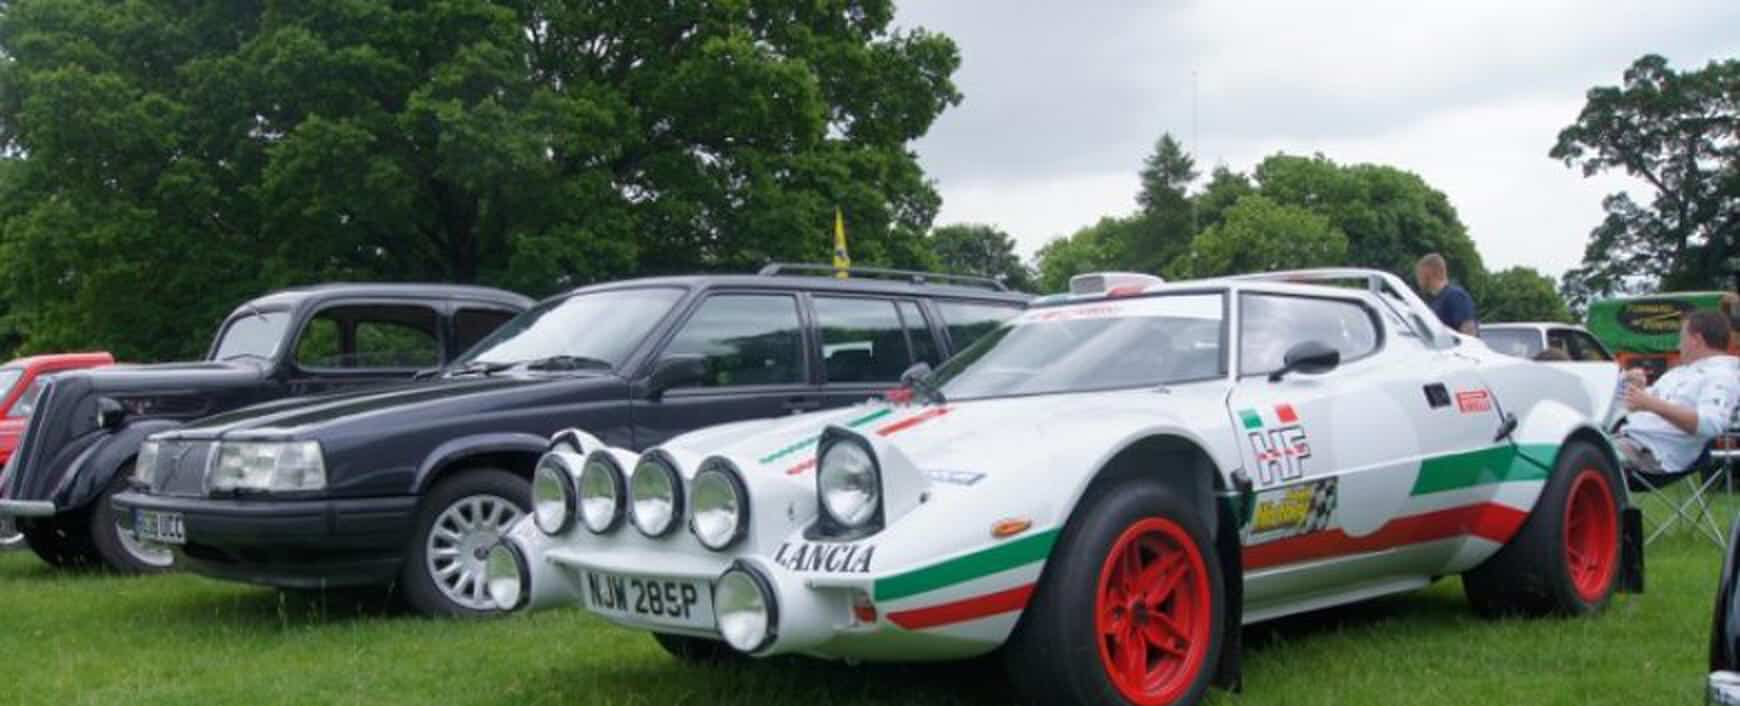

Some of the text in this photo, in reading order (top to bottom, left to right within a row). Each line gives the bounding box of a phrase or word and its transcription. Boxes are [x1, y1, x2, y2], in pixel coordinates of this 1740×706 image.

[1248, 425, 1312, 485] HF
[774, 543, 875, 573] LANCIA
[588, 572, 698, 619] NJW 285P
